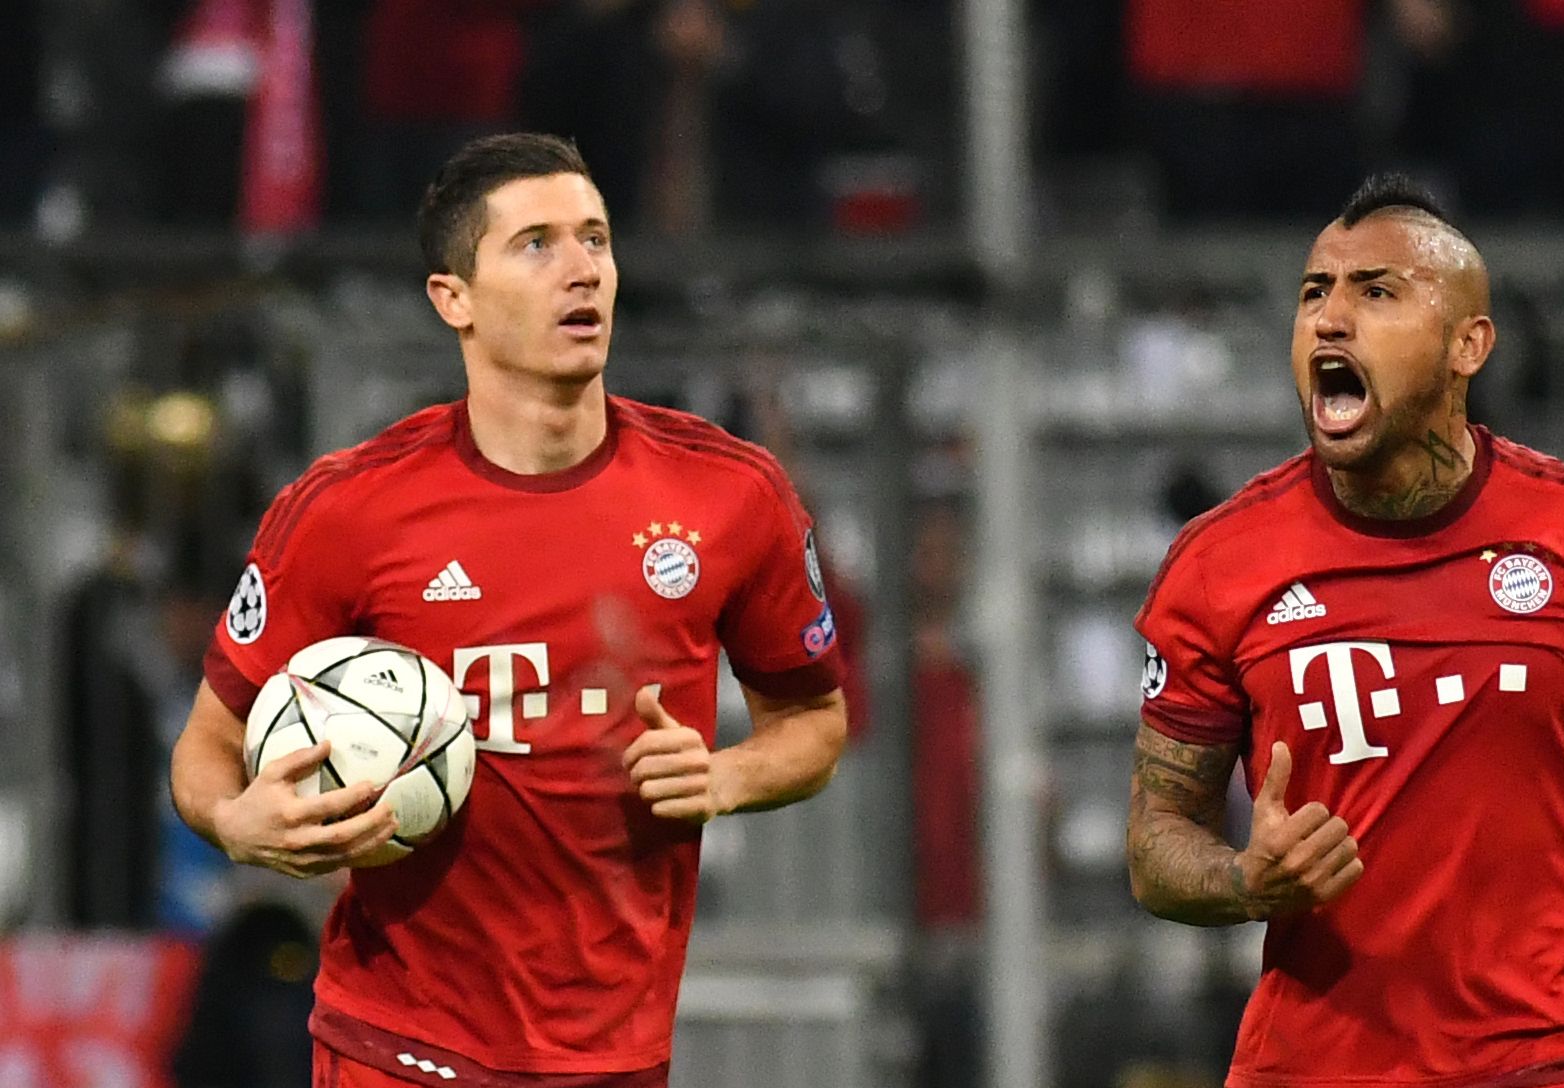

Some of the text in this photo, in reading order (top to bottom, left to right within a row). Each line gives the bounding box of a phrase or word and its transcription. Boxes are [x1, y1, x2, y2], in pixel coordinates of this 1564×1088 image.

[1504, 557, 1549, 581] BAYERN
[422, 585, 482, 602] adidas
[1266, 603, 1327, 625] adidas
